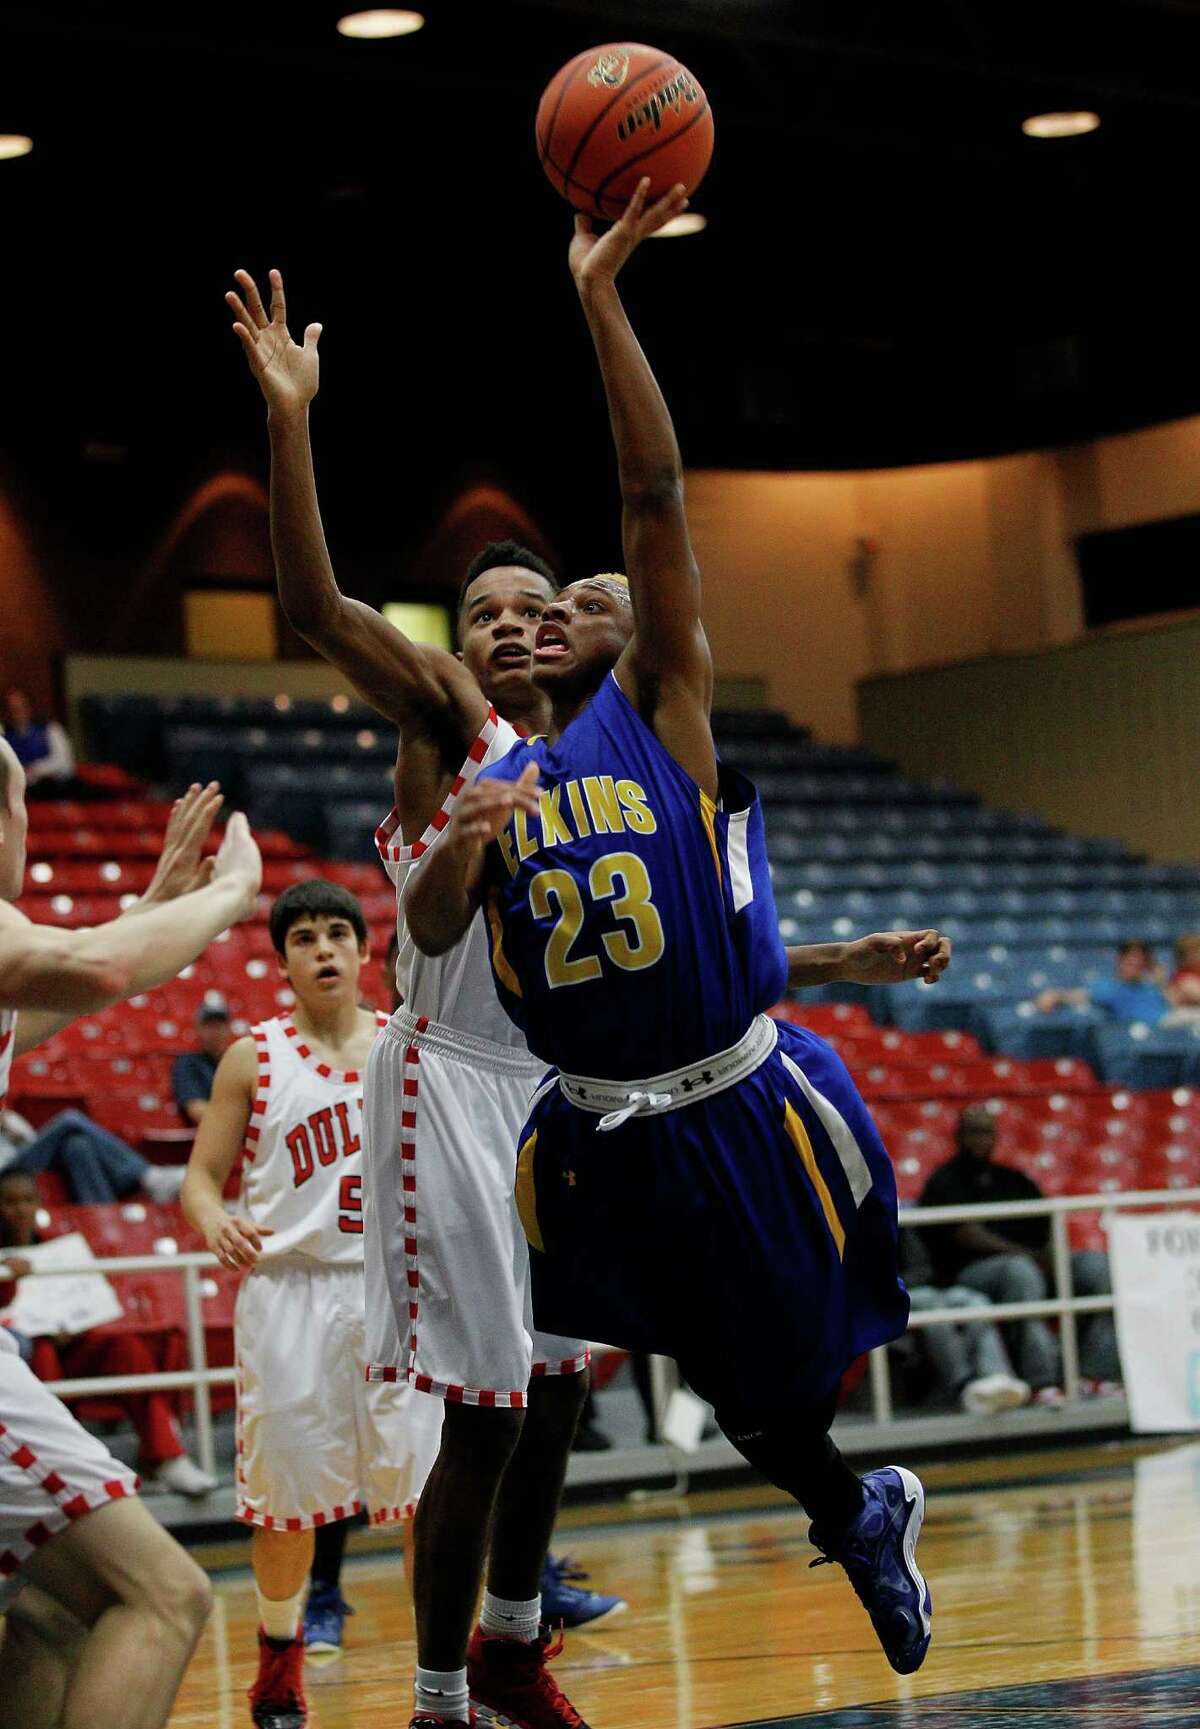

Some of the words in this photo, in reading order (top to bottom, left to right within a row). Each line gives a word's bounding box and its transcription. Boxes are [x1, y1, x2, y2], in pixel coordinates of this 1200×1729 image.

[617, 70, 697, 142] Baden
[497, 775, 657, 880] ELKINS
[529, 851, 665, 989] 23
[285, 1098, 363, 1189] DUL
